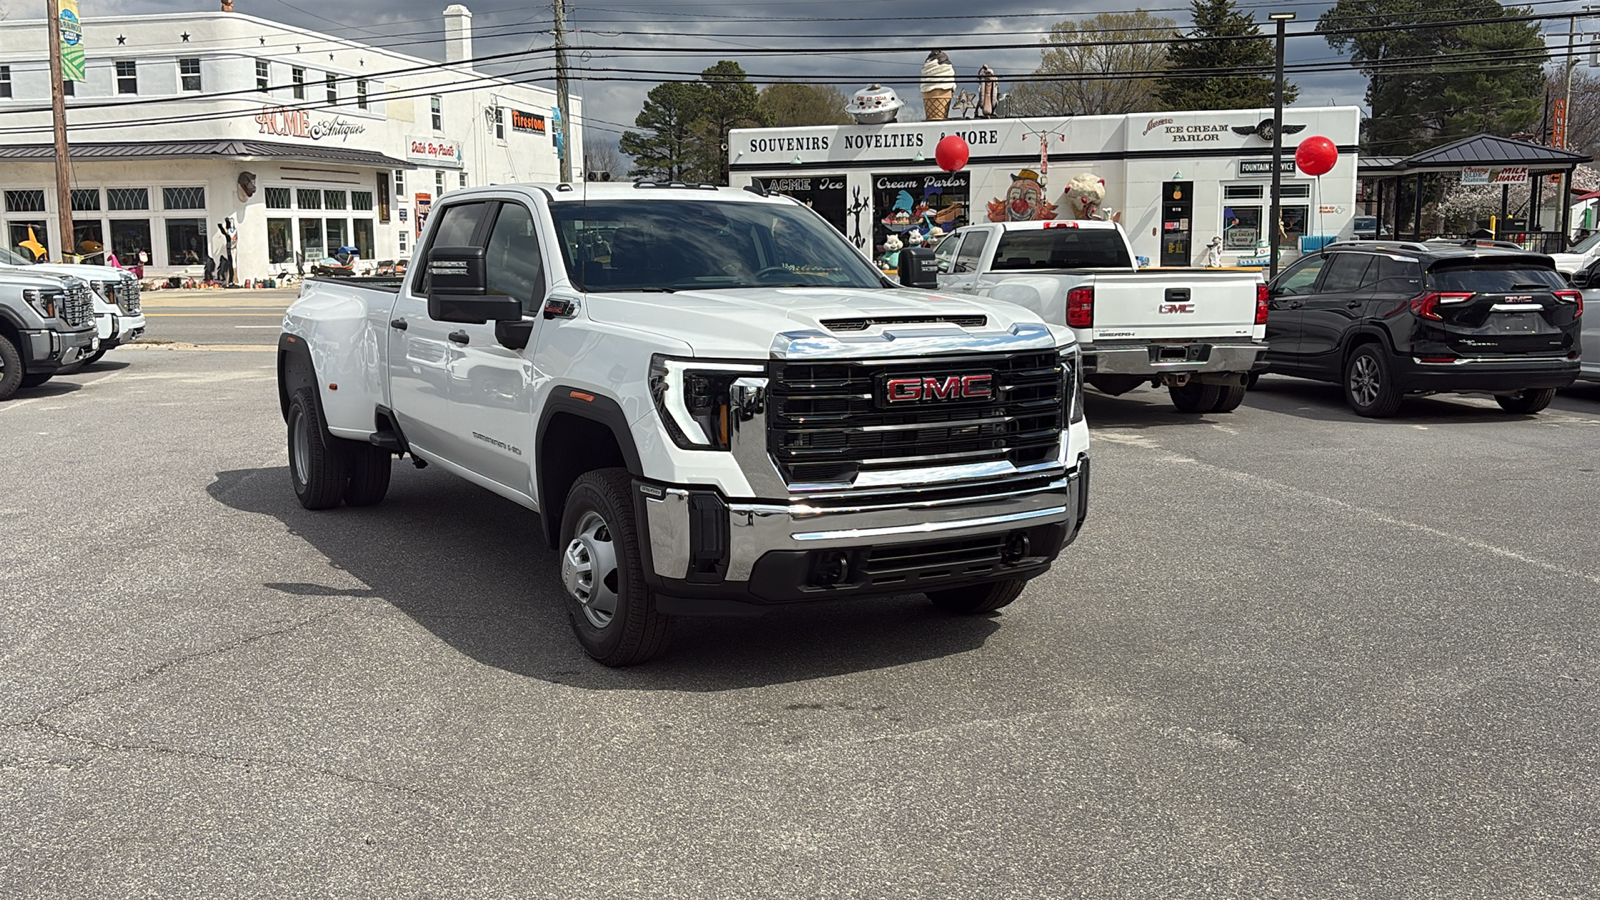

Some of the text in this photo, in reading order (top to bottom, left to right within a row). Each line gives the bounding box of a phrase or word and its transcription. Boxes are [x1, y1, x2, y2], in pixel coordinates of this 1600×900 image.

[255, 104, 366, 142] ACME Antiques
[512, 110, 545, 131] Firestone
[1165, 124, 1229, 134] ICE CREAM
[750, 136, 829, 153] SOUVENIRS
[844, 132, 924, 149] NOVELTIES
[1172, 134, 1220, 142] PARLOR
[427, 142, 438, 158] Boy
[438, 144, 454, 157] Paints
[1242, 163, 1270, 172] FOUNTAIN
[769, 175, 967, 191] ACME Ice Cream Parlor
[1494, 174, 1527, 182] SHAKES
[1505, 295, 1533, 304] GMC
[1159, 304, 1195, 315] GMC
[886, 372, 994, 402] GMC
